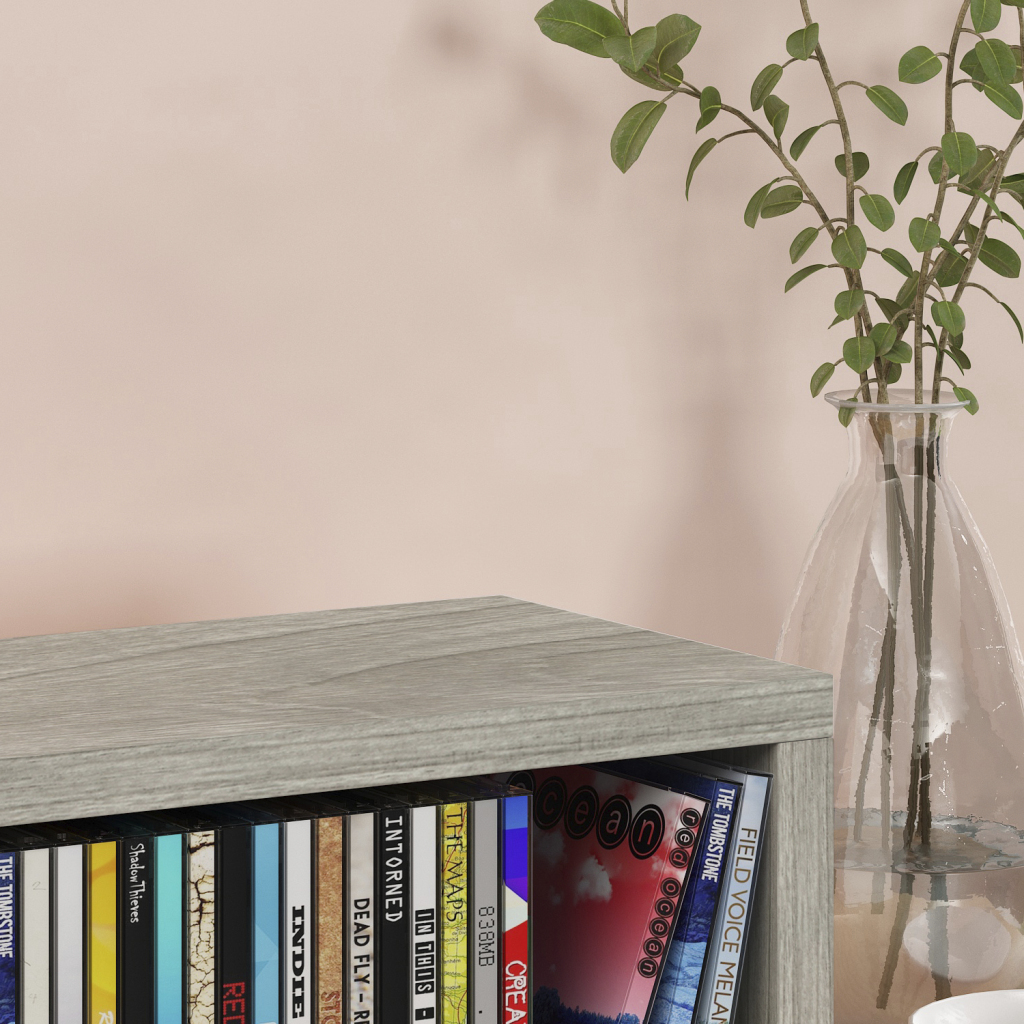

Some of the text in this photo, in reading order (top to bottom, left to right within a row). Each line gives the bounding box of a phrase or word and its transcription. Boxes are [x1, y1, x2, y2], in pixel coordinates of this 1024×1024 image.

[447, 807, 463, 854] THE
[513, 777, 660, 852] cean
[702, 788, 735, 883] THE TOMBSTONE
[385, 816, 403, 922] INTORNED
[734, 827, 758, 884] FIELD
[447, 861, 463, 921] MAPS
[639, 810, 699, 976] red ocean
[354, 898, 370, 946] DEAD
[416, 911, 433, 935] IN
[478, 906, 495, 967] 838MB
[722, 890, 748, 953] VOICE
[292, 905, 305, 1018] INDIE
[354, 954, 370, 984] FLY
[416, 942, 433, 993] THIS
